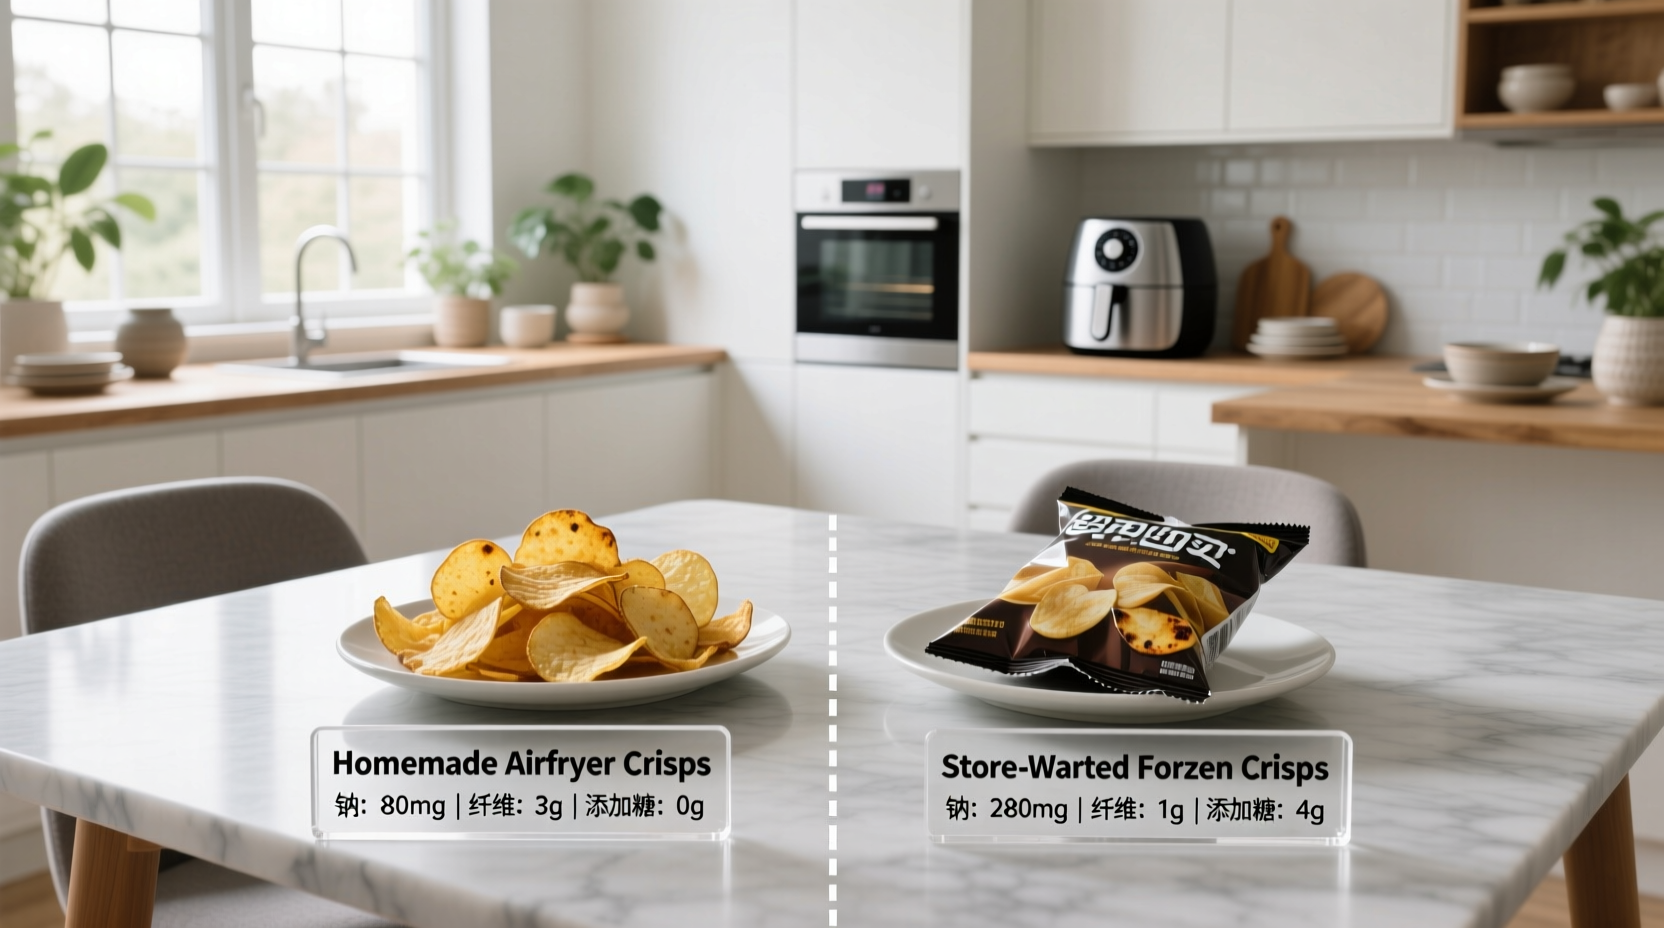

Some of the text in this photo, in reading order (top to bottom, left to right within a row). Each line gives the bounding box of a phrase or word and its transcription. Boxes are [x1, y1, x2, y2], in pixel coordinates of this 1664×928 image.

[333, 748, 712, 783] Homemade Airfryer Crisps
[941, 752, 1330, 787] Store-Warted Forzen Crisps
[380, 794, 446, 821] 80mg
[534, 794, 563, 821] 3g
[676, 794, 704, 821] 0g
[990, 797, 1068, 825] 280mg
[1158, 798, 1184, 826] 1g
[1295, 799, 1325, 826] 4g
